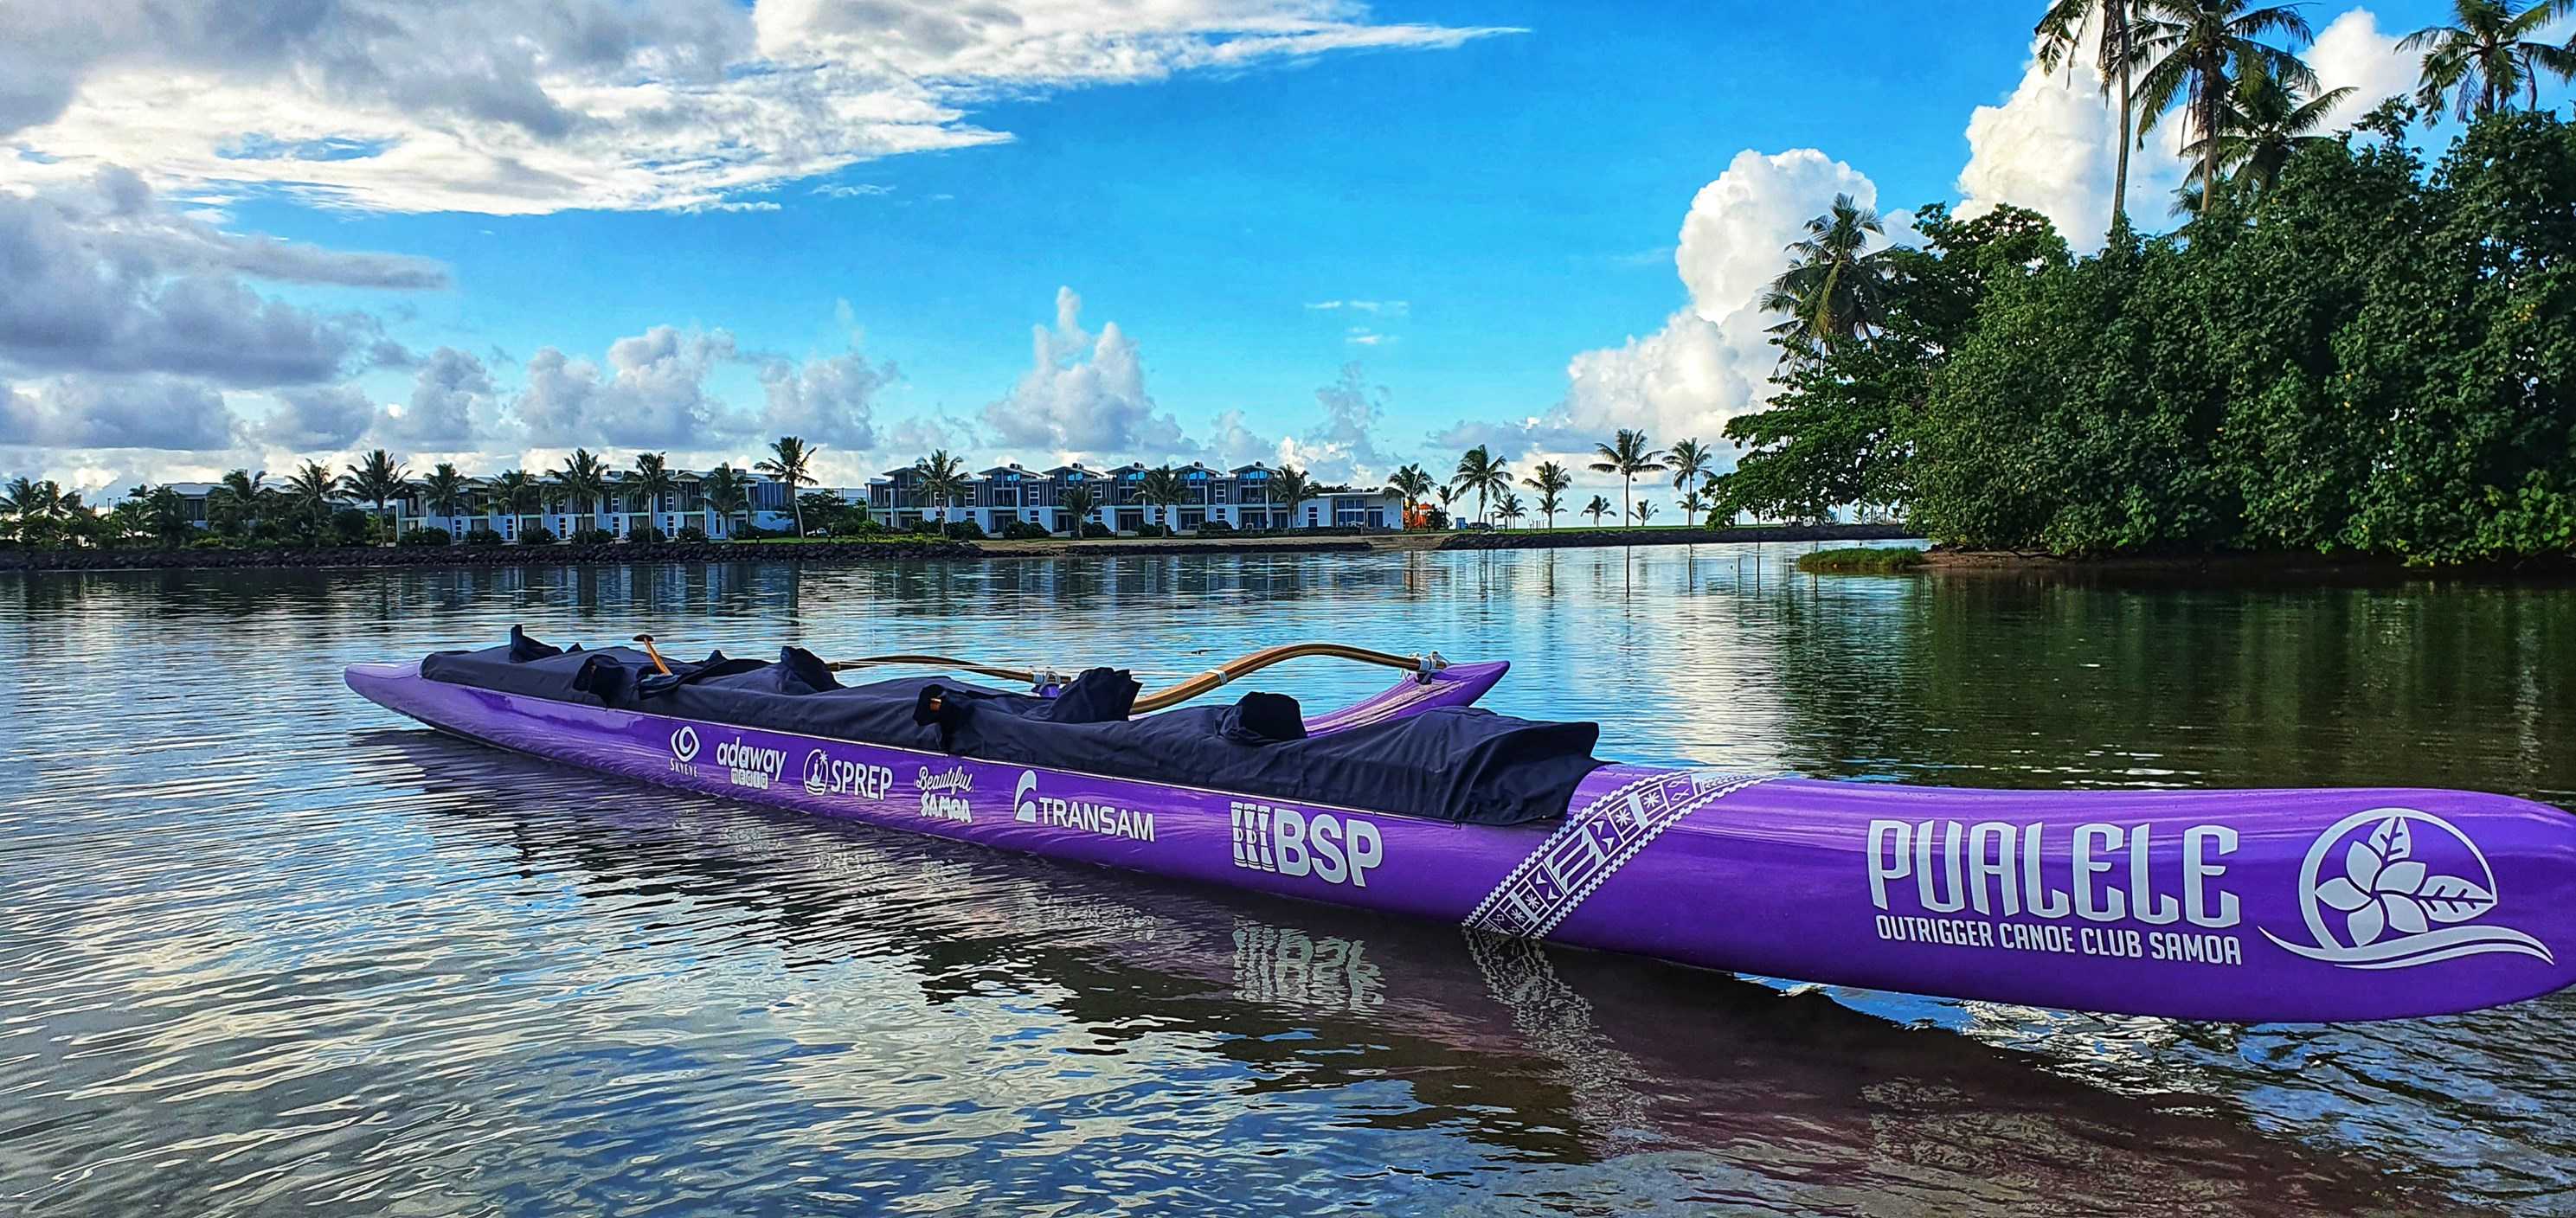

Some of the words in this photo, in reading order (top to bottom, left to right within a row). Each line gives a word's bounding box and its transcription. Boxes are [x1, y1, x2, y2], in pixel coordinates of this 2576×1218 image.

[716, 736, 787, 782] adaway
[831, 760, 893, 800] SPREP
[915, 766, 973, 795] Beautiful
[920, 791, 973, 823] SAMOA
[1039, 797, 1154, 842] TRANSAM
[1274, 807, 1383, 888] BSP
[1867, 819, 2240, 927] PUALELE
[1875, 914, 1995, 948] OUTRIGGER
[1999, 922, 2076, 953] CANOE
[2080, 927, 2143, 958] CLUB
[2148, 931, 2243, 965] SAMOA
